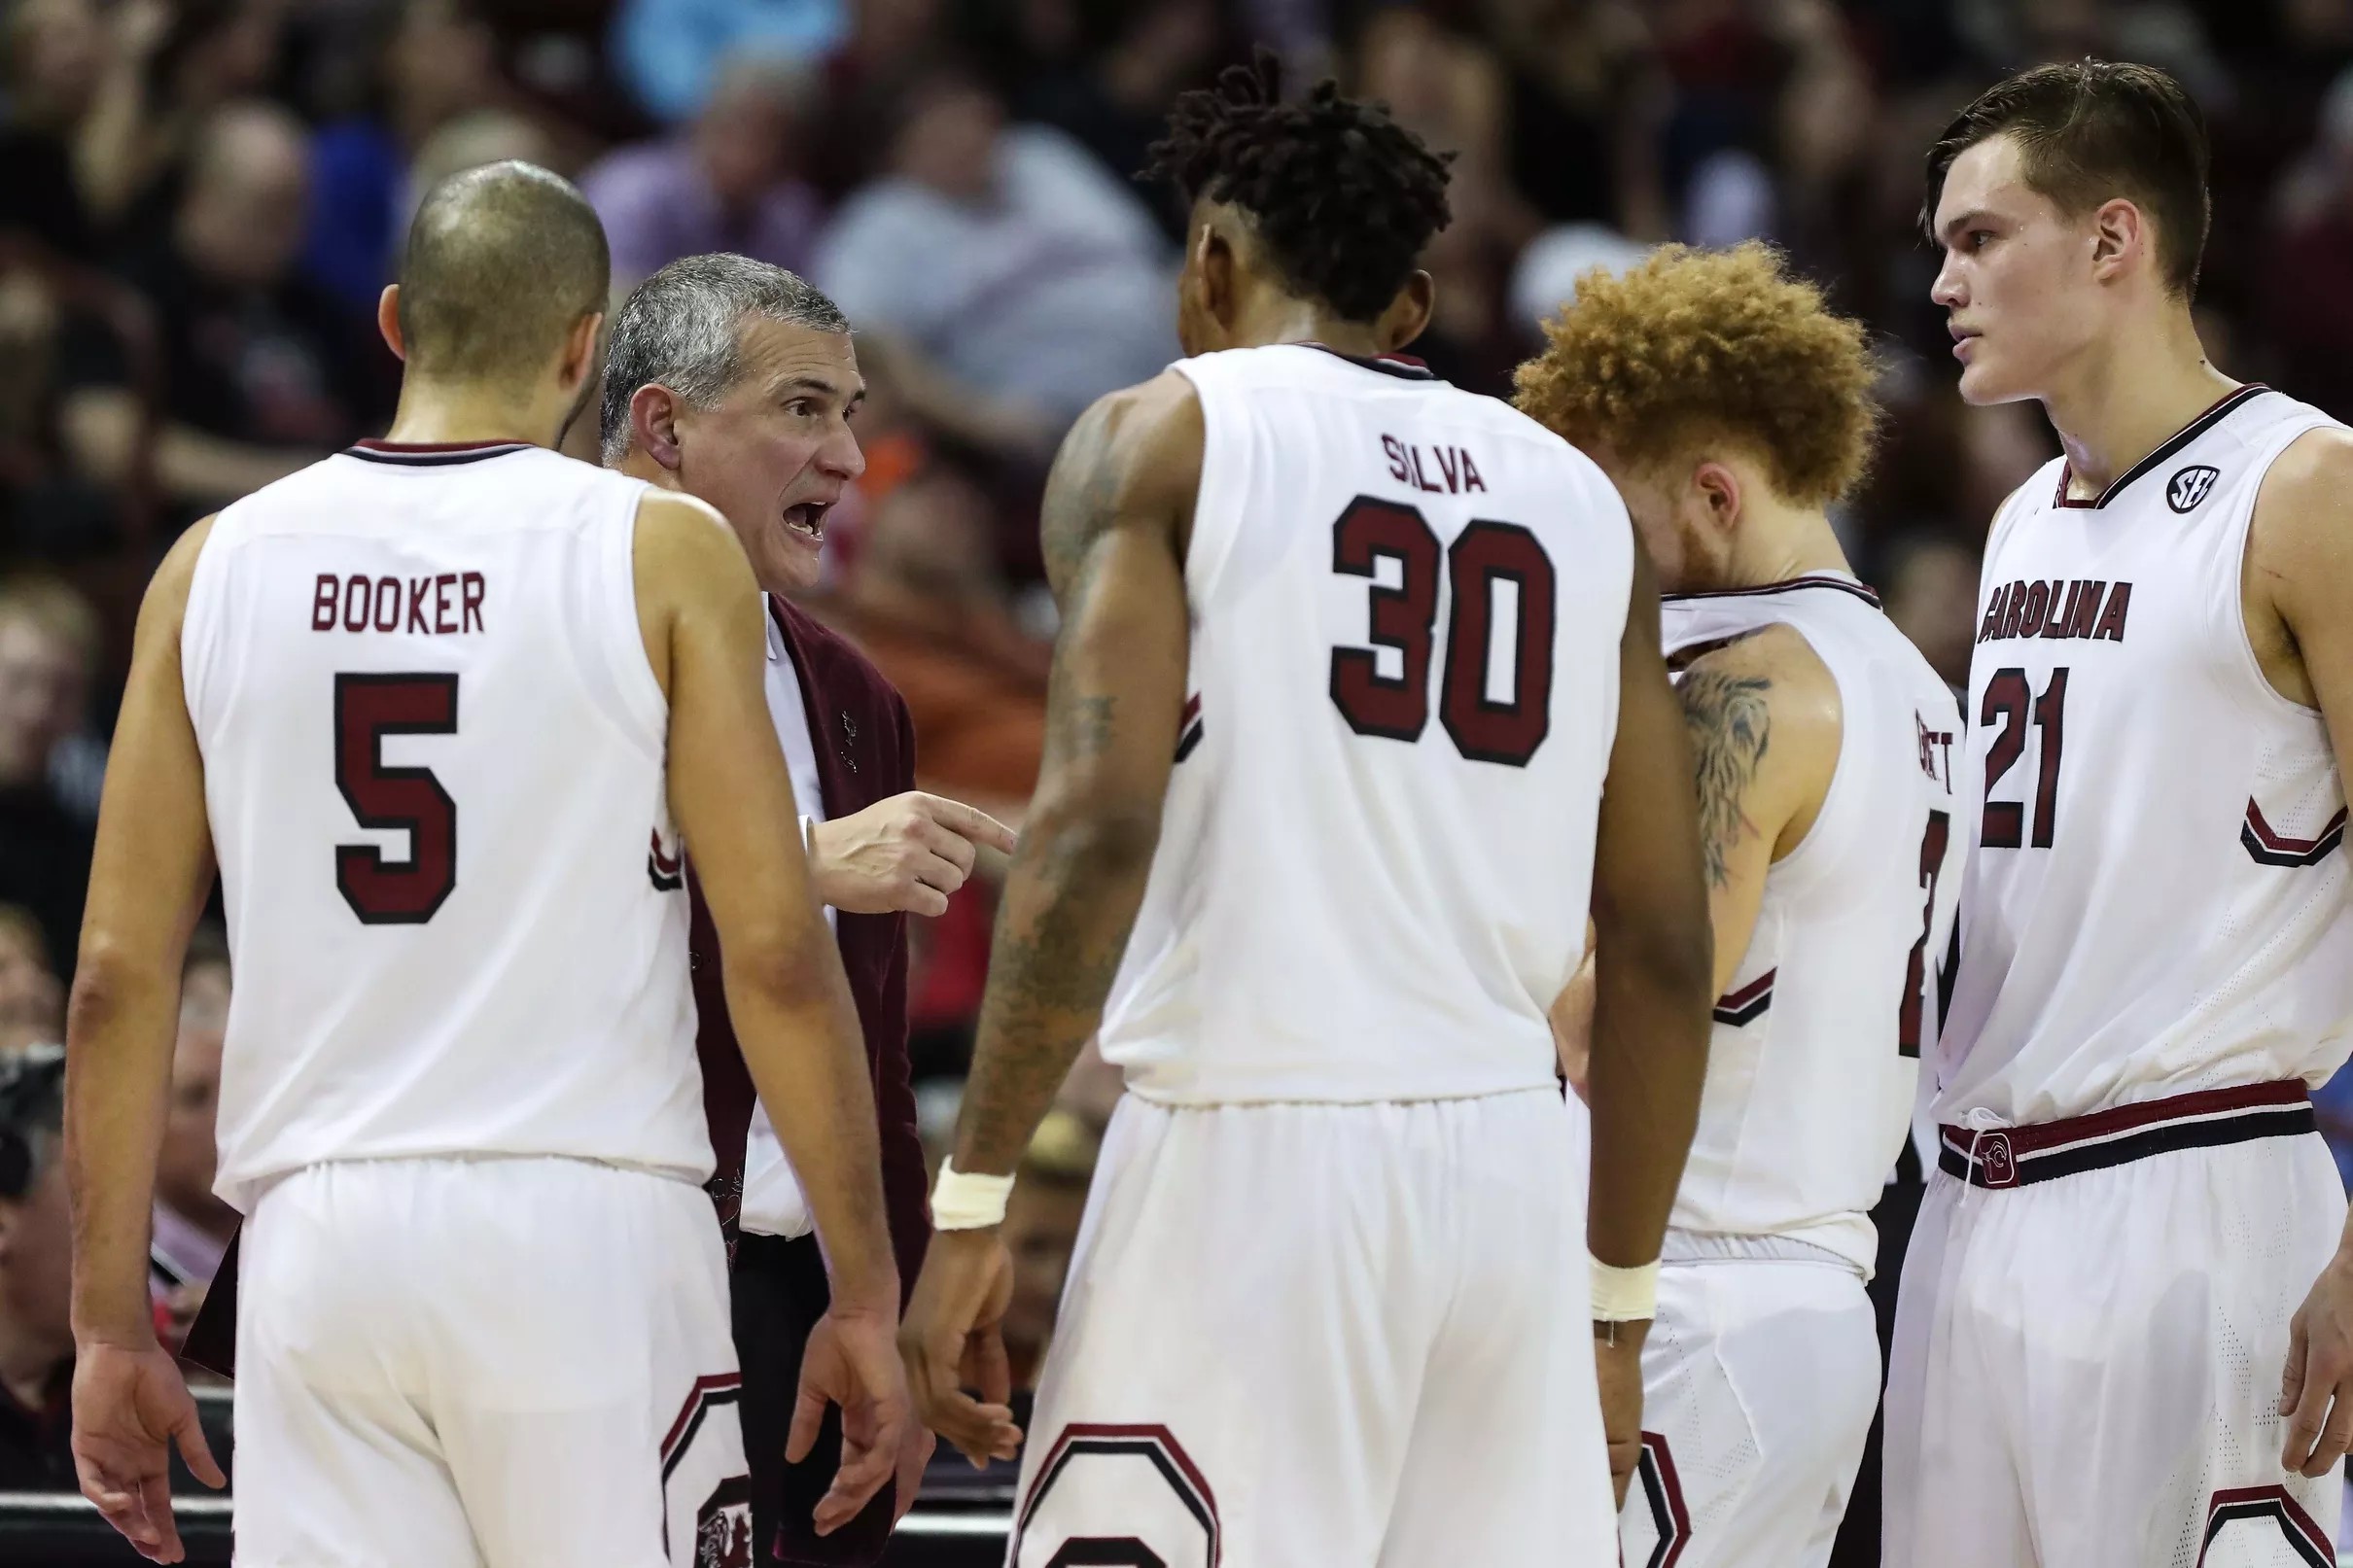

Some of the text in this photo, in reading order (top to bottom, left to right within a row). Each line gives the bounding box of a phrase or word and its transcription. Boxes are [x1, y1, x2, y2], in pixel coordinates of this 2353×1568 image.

[1381, 433, 1488, 494] SILVA
[2169, 467, 2218, 511] SEC
[312, 572, 485, 635] BOOKER
[1329, 494, 1557, 768] 30
[334, 672, 459, 924] 5
[1980, 667, 2070, 849] 21
